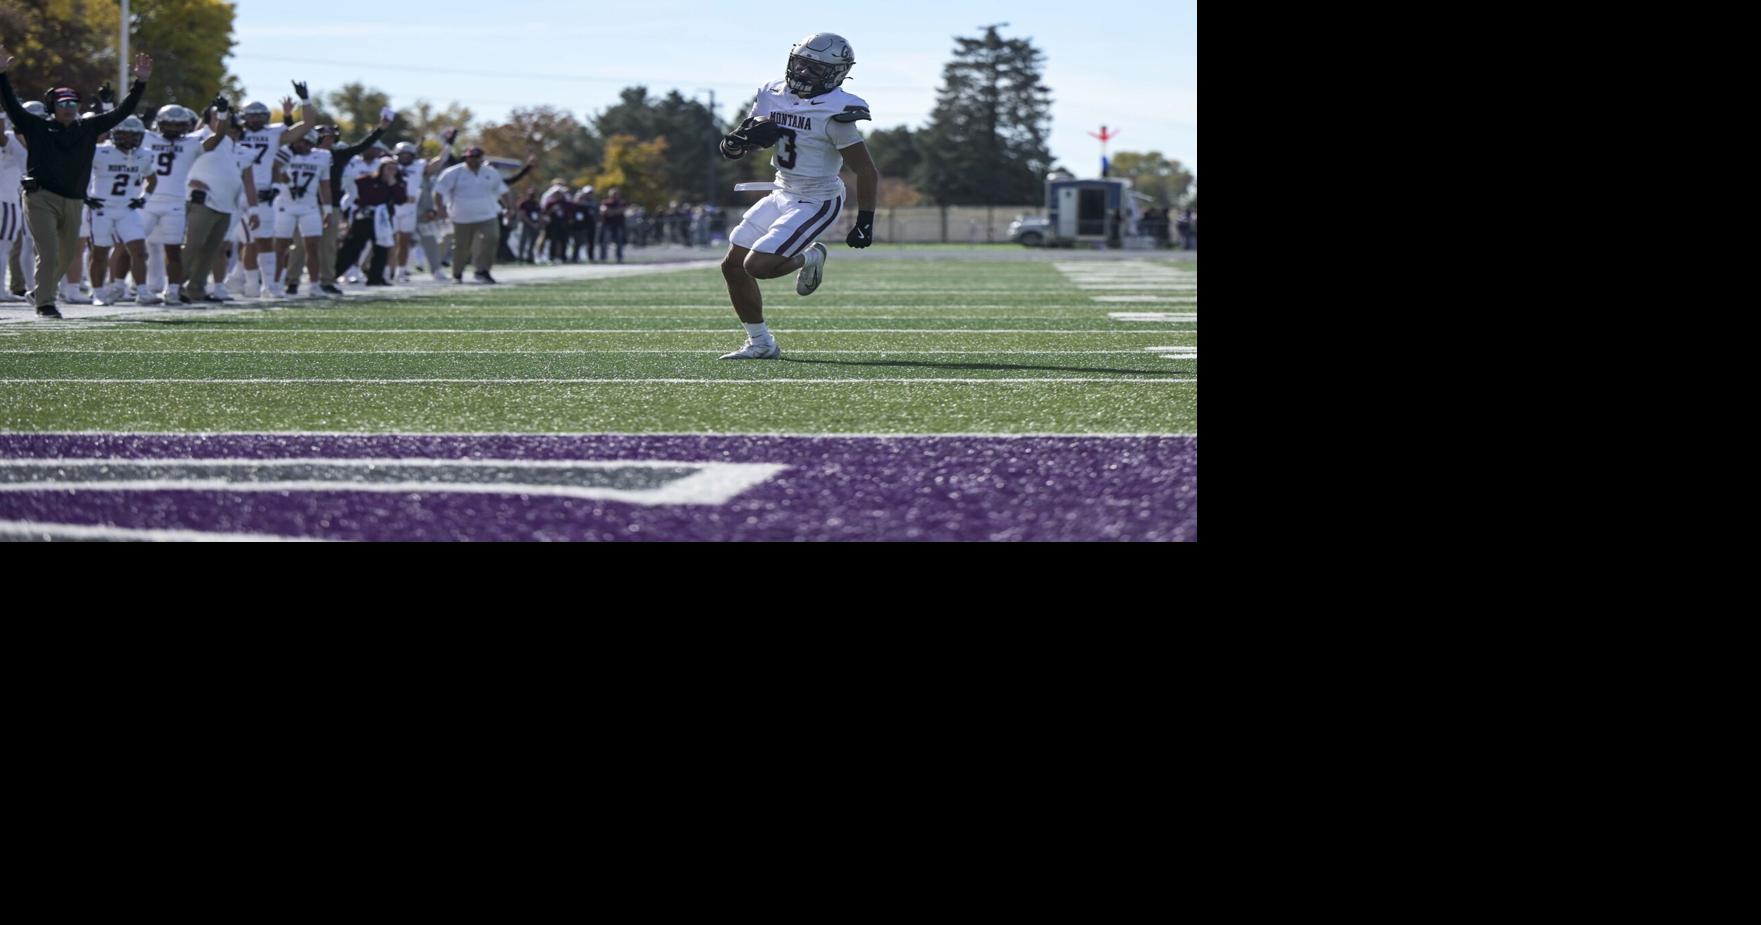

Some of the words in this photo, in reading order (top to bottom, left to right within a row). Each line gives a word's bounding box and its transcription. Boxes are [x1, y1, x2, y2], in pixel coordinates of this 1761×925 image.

[769, 111, 812, 130] MONTANA
[241, 143, 269, 165] 7
[776, 127, 797, 169] 3
[156, 152, 174, 176] 9
[111, 173, 130, 196] 2
[291, 171, 316, 192] 17
